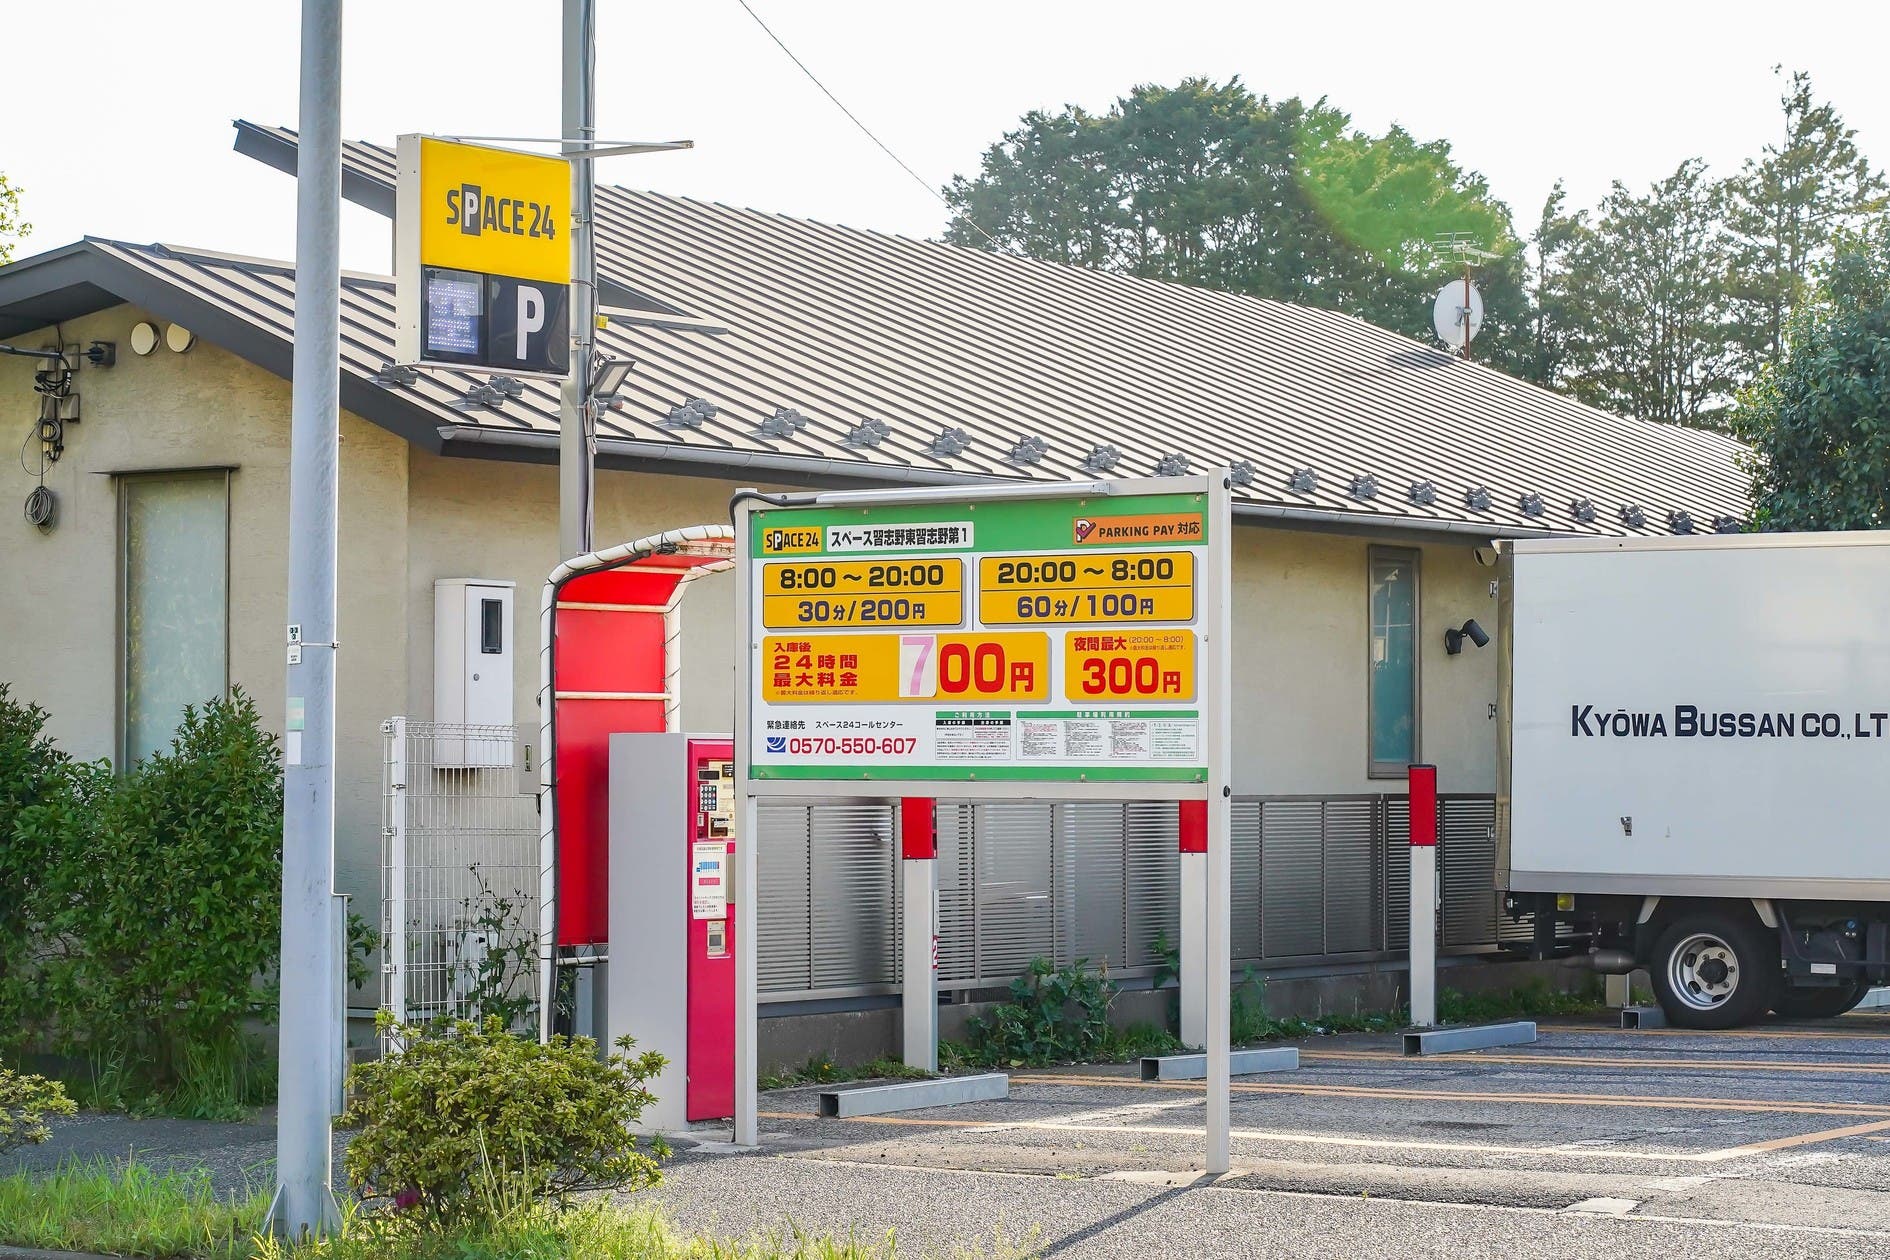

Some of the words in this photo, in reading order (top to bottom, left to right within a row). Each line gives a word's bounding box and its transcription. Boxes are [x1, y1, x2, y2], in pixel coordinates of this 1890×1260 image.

[446, 185, 524, 236] SPACE
[529, 202, 556, 240] 24
[516, 284, 546, 361] P
[765, 530, 804, 550] SPACE
[806, 532, 819, 547] 24
[831, 526, 968, 547] スペース習志野東習志野第1
[1099, 525, 1149, 538] PARKING
[1153, 524, 1175, 536] PAY
[1177, 520, 1200, 535] 対応
[780, 567, 836, 589] 8:00
[868, 564, 944, 587] 20:00
[998, 560, 1077, 584] 20:00
[1111, 558, 1174, 581] 8:00
[798, 598, 926, 622] 30分/200円
[1017, 593, 1154, 618] 60分/100円
[773, 642, 812, 653] 入庫後
[1073, 636, 1127, 652] 夜間最大
[902, 636, 1034, 696] 700円
[1082, 657, 1181, 695] 300円
[766, 720, 806, 730] 緊急連絡先
[815, 720, 904, 729] スペース24コールセンター
[1674, 705, 1795, 738] BUSSAN
[789, 737, 917, 754] 0570-550-607
